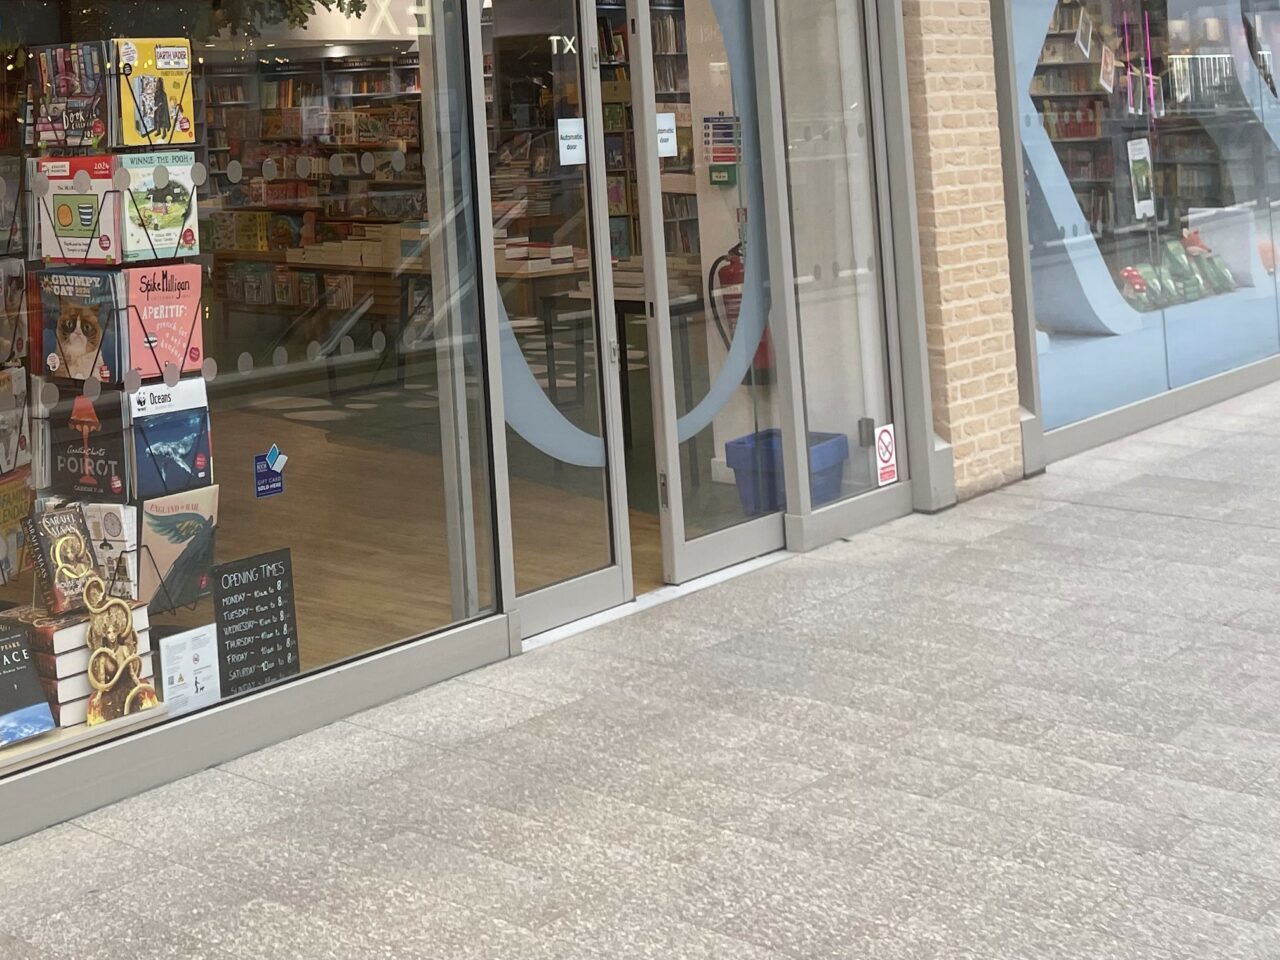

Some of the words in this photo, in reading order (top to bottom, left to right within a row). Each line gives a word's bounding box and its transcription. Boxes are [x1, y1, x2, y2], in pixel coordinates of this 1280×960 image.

[157, 50, 172, 60] DARTH
[172, 50, 187, 59] VADER
[171, 155, 189, 164] POOH
[52, 274, 101, 289] GRUMPY
[139, 272, 161, 301] Spike
[161, 270, 190, 298] Milligan
[53, 285, 74, 297] CAT
[150, 392, 172, 406] Oceans
[57, 455, 118, 477] POIROT
[257, 483, 269, 492] SOLD
[269, 481, 282, 489] HERE
[222, 568, 259, 589] OPENING
[259, 561, 285, 578] TIMES
[222, 592, 245, 606] MONDAY
[0, 641, 21, 652] PEAKE
[227, 651, 248, 664] FRIDAY
